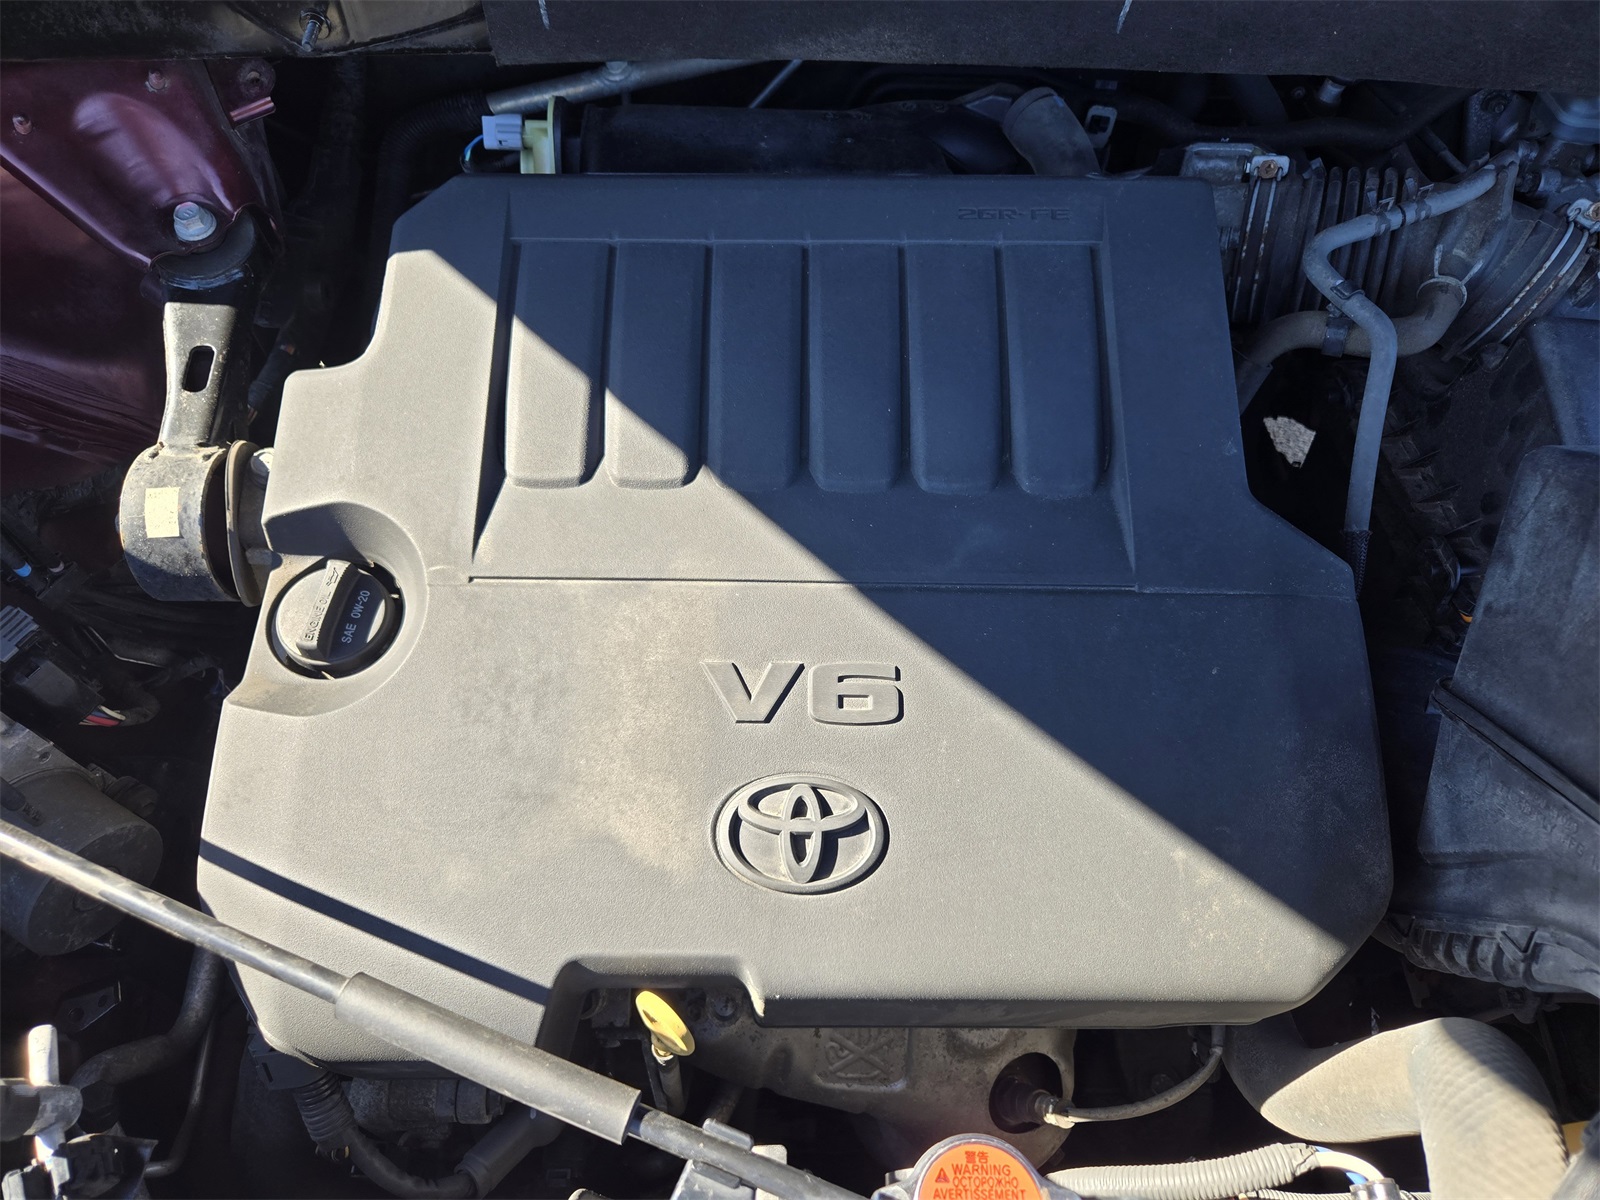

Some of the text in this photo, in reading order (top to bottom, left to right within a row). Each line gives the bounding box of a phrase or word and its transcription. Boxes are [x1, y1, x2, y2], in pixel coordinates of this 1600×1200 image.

[304, 605, 325, 641] ENGINE
[342, 590, 371, 644] SAE 0W-20
[699, 660, 905, 726] V6
[964, 1150, 989, 1164] 警告
[951, 1163, 1011, 1176] WARNING
[952, 1176, 1019, 1189] ОСТОРОЖНО
[933, 1188, 1026, 1200] AVERTISSEMENT
